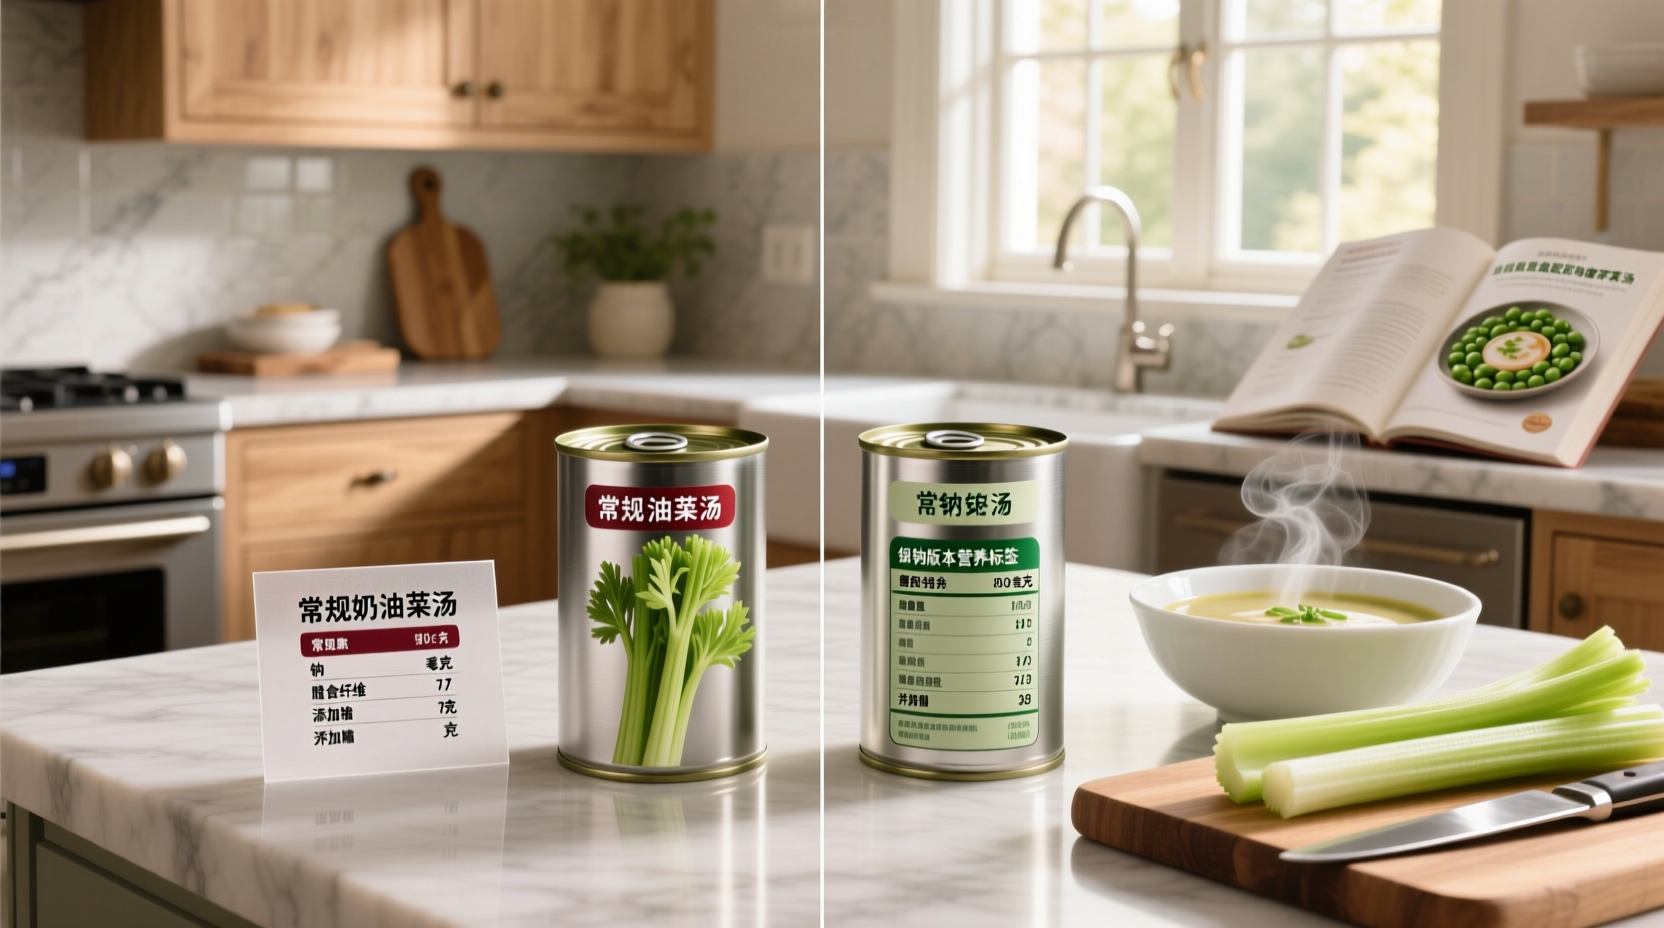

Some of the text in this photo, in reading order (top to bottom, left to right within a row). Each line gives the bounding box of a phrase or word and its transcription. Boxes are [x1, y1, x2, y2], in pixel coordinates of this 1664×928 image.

[598, 494, 722, 523] 常规油菜汤
[298, 590, 458, 624] 常规奶油菜汤
